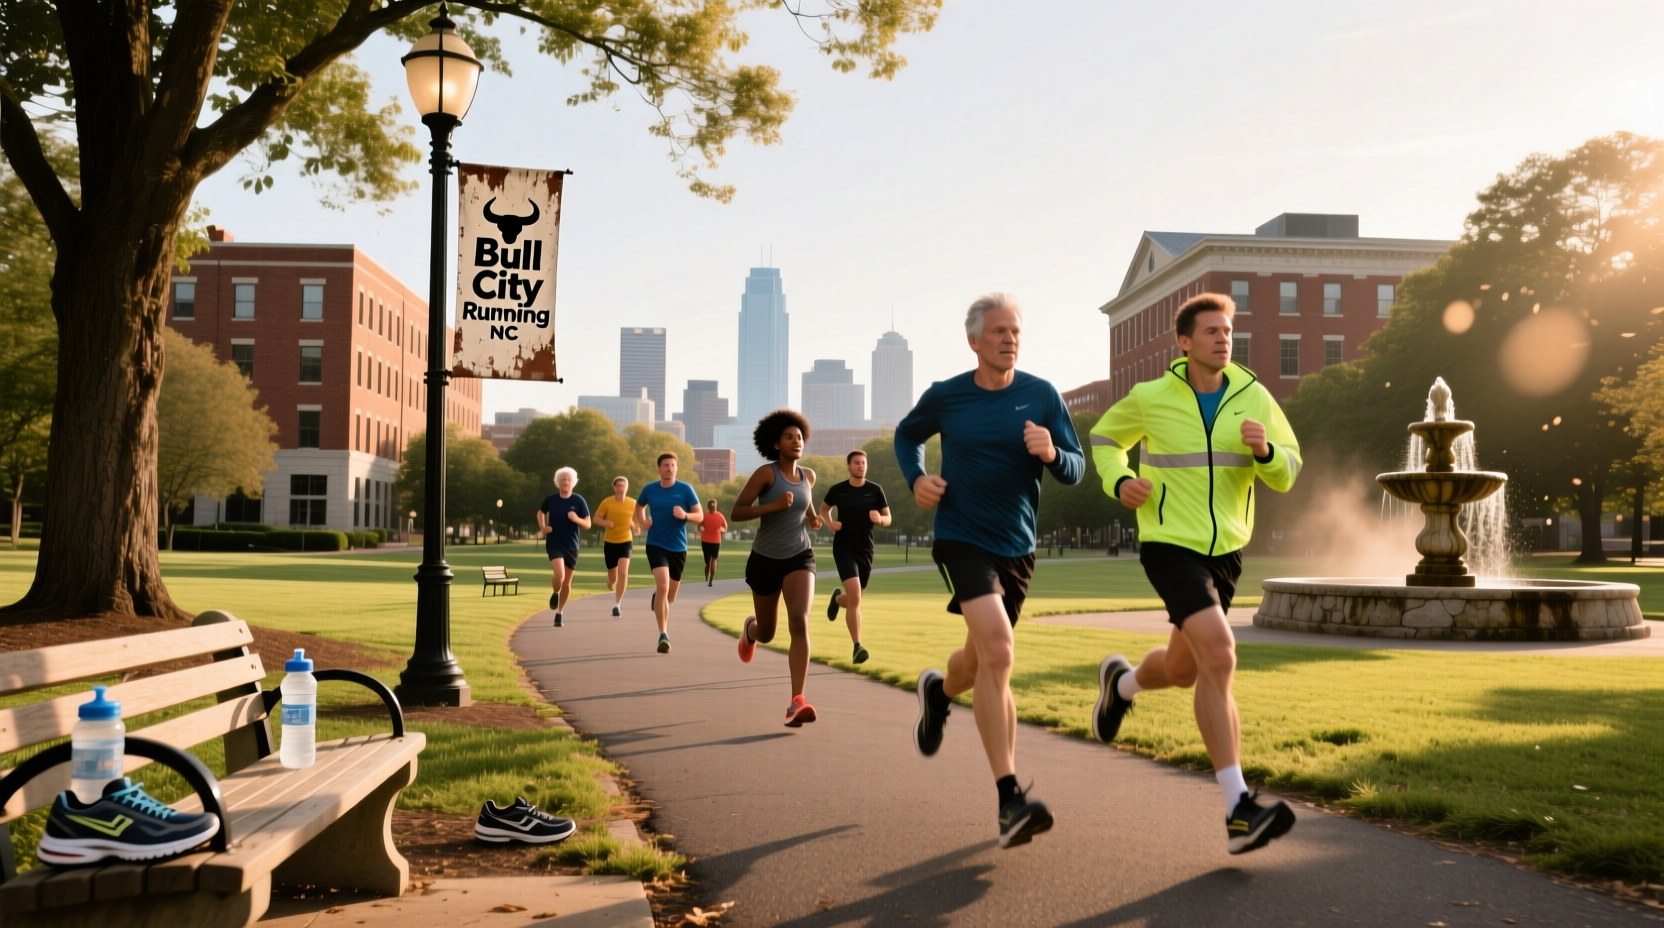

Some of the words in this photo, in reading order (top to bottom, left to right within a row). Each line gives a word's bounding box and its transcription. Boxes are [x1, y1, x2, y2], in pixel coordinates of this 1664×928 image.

[474, 237, 542, 271] Bull
[472, 270, 544, 307] City
[462, 301, 550, 328] Running
[490, 325, 518, 340] NC
